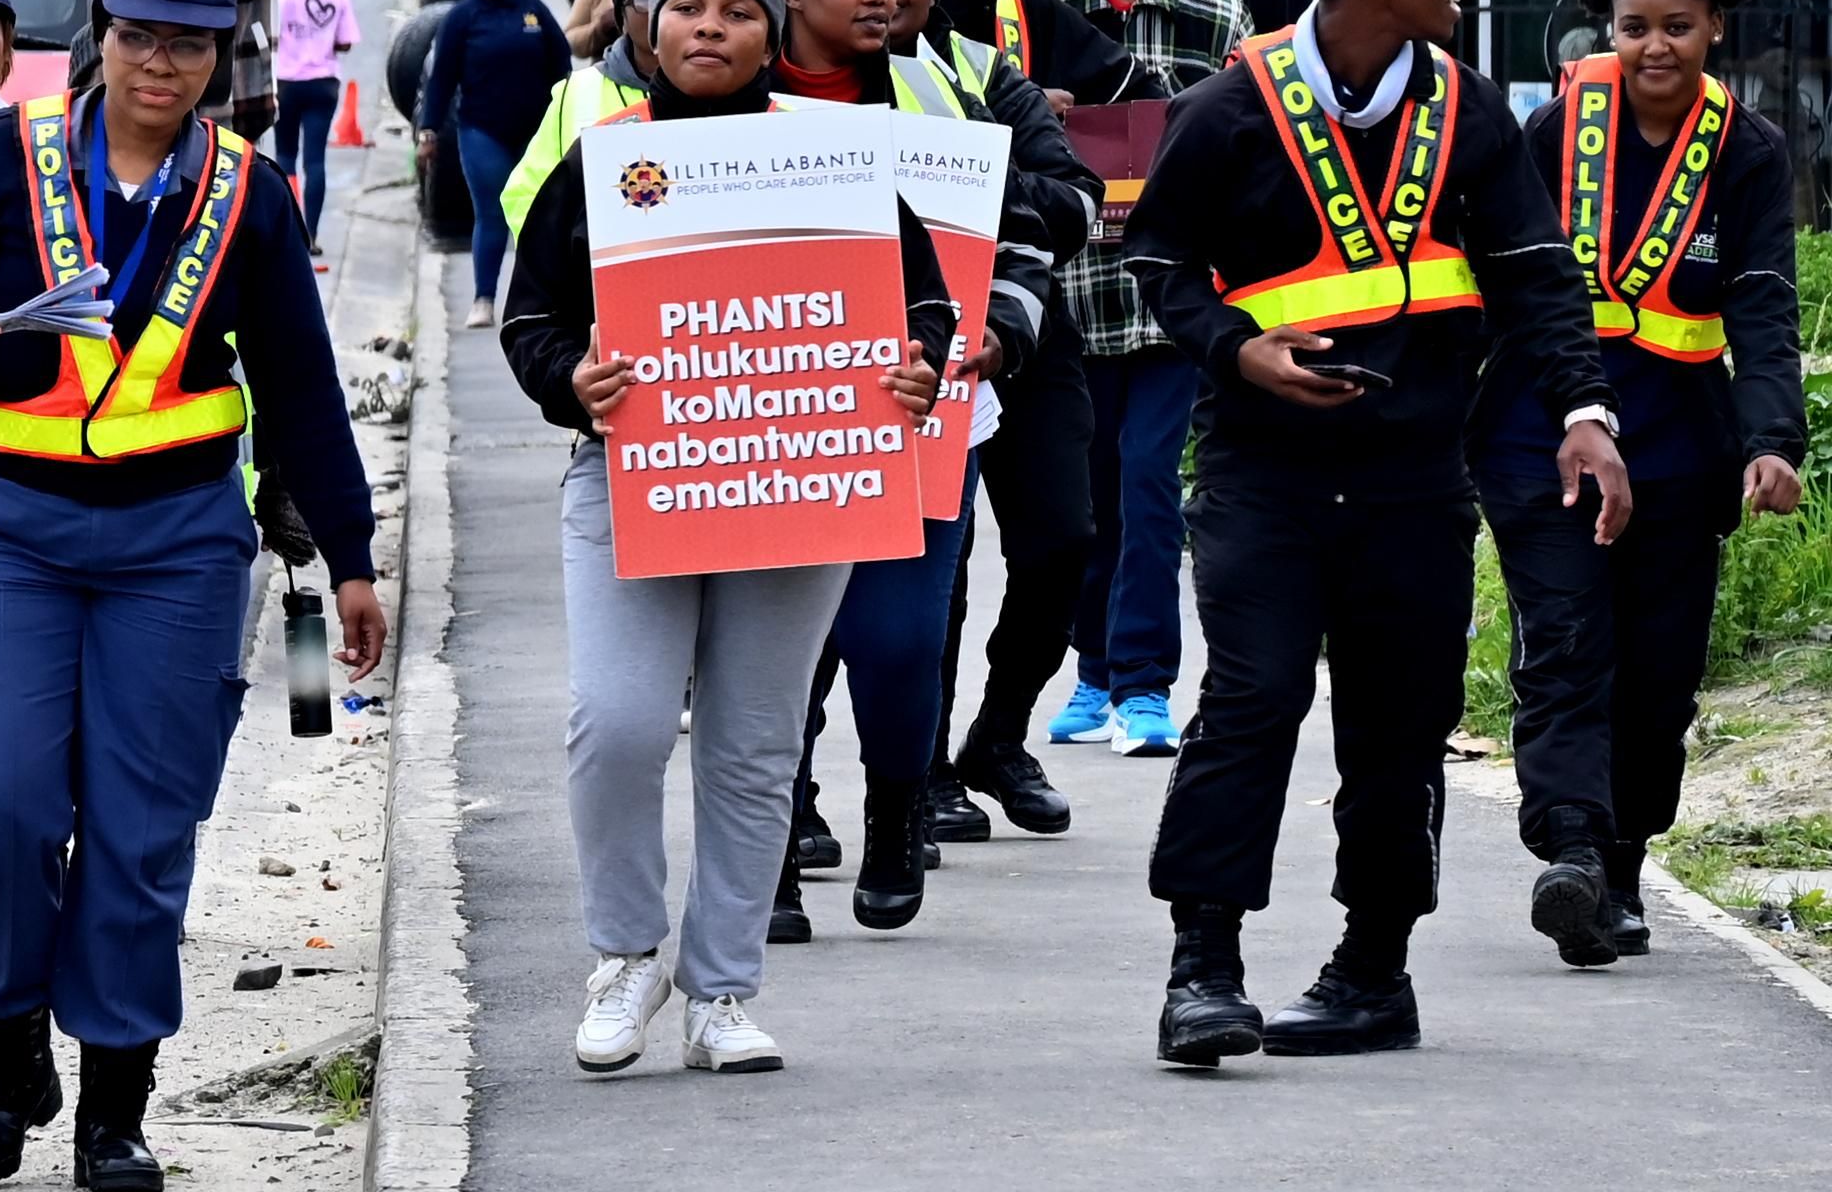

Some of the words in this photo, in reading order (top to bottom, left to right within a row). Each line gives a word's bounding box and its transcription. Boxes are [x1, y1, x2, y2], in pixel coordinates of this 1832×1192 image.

[674, 159, 759, 181] ILITHA
[771, 150, 875, 173] LABANTU
[899, 149, 991, 174] LABANTU
[912, 169, 947, 183] ABOUT
[950, 174, 987, 188] PEOPLE
[1266, 47, 1375, 263] POLICE
[676, 184, 719, 196] PEOPLE
[723, 181, 753, 193] WHO
[755, 179, 787, 190] CARE
[790, 175, 829, 187] ABOUT
[833, 171, 875, 184] PEOPLE
[1572, 91, 1608, 295] POLICE
[1620, 109, 1721, 296] POLICE
[164, 150, 235, 316] POLICE
[659, 290, 846, 338] PHANTSI
[611, 336, 901, 385] ohlukumeza
[661, 383, 857, 425] koMama
[621, 424, 904, 472] nabantwana
[647, 469, 884, 513] emakhaya
